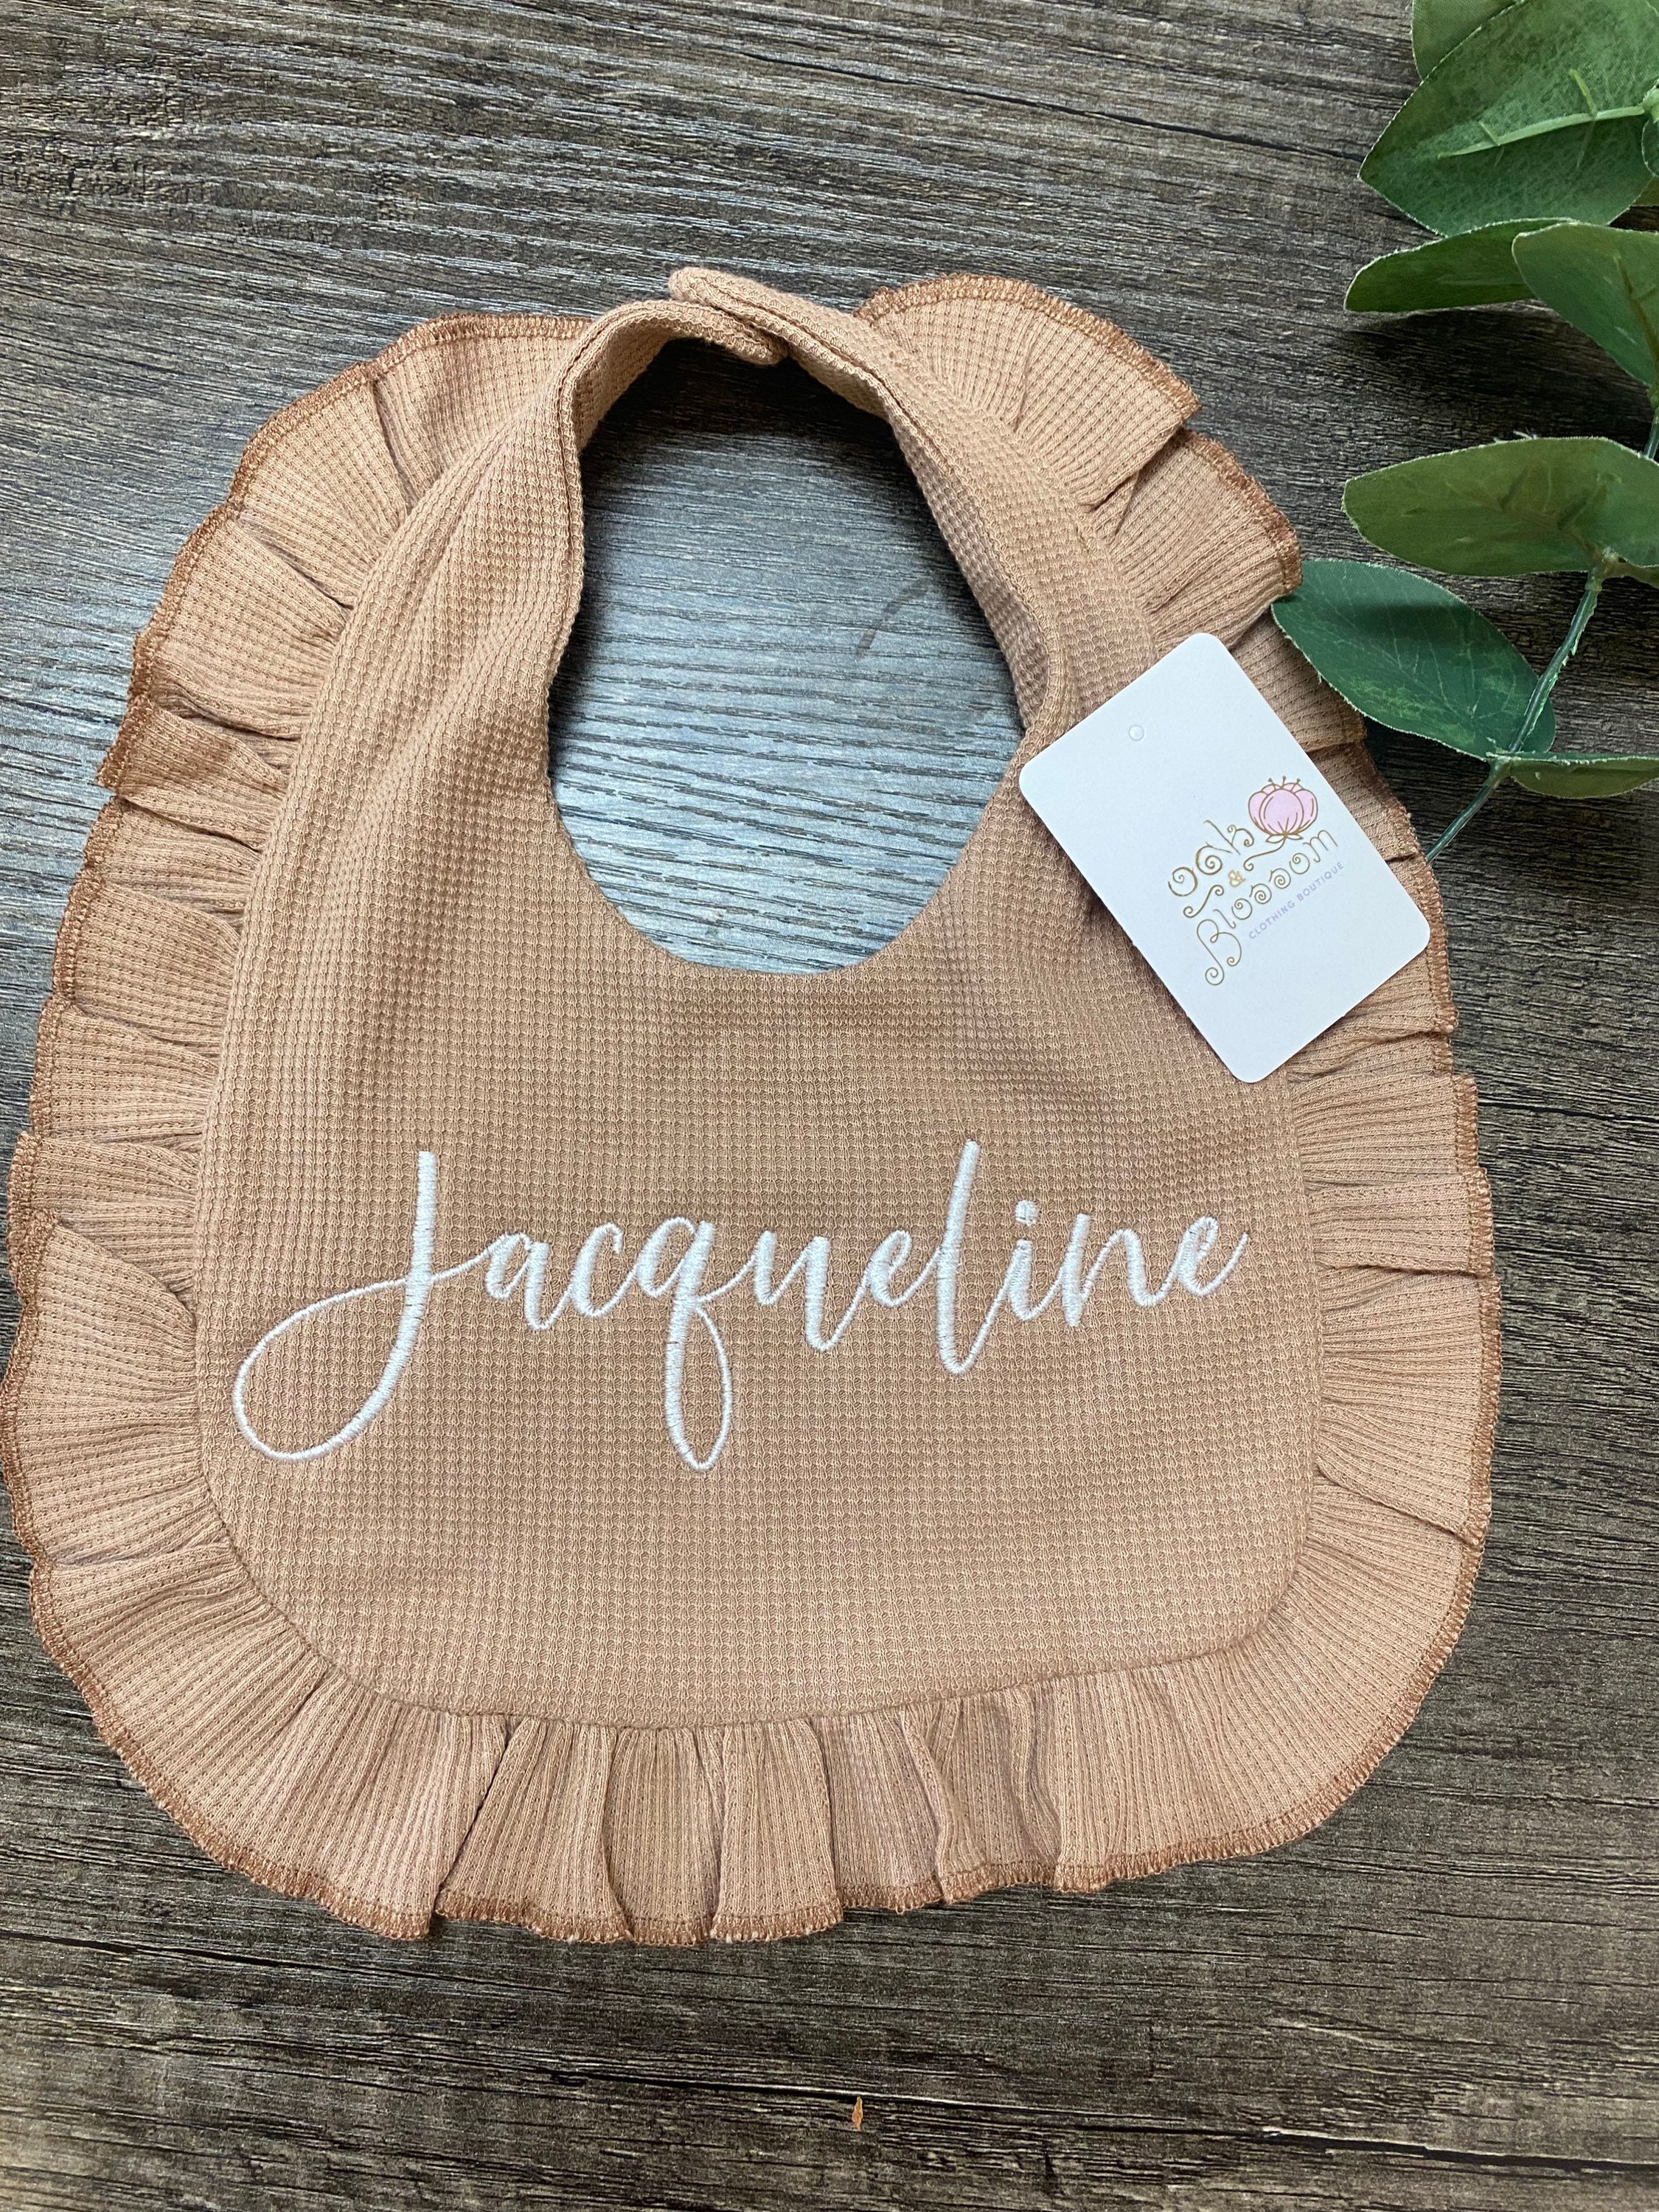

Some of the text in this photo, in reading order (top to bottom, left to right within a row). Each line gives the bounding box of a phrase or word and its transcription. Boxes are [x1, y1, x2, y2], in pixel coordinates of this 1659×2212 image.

[1227, 869, 1247, 888] &
[1248, 861, 1345, 940] CLOTHING BOUTIQUE
[232, 1140, 1248, 1472] Jacqueline
